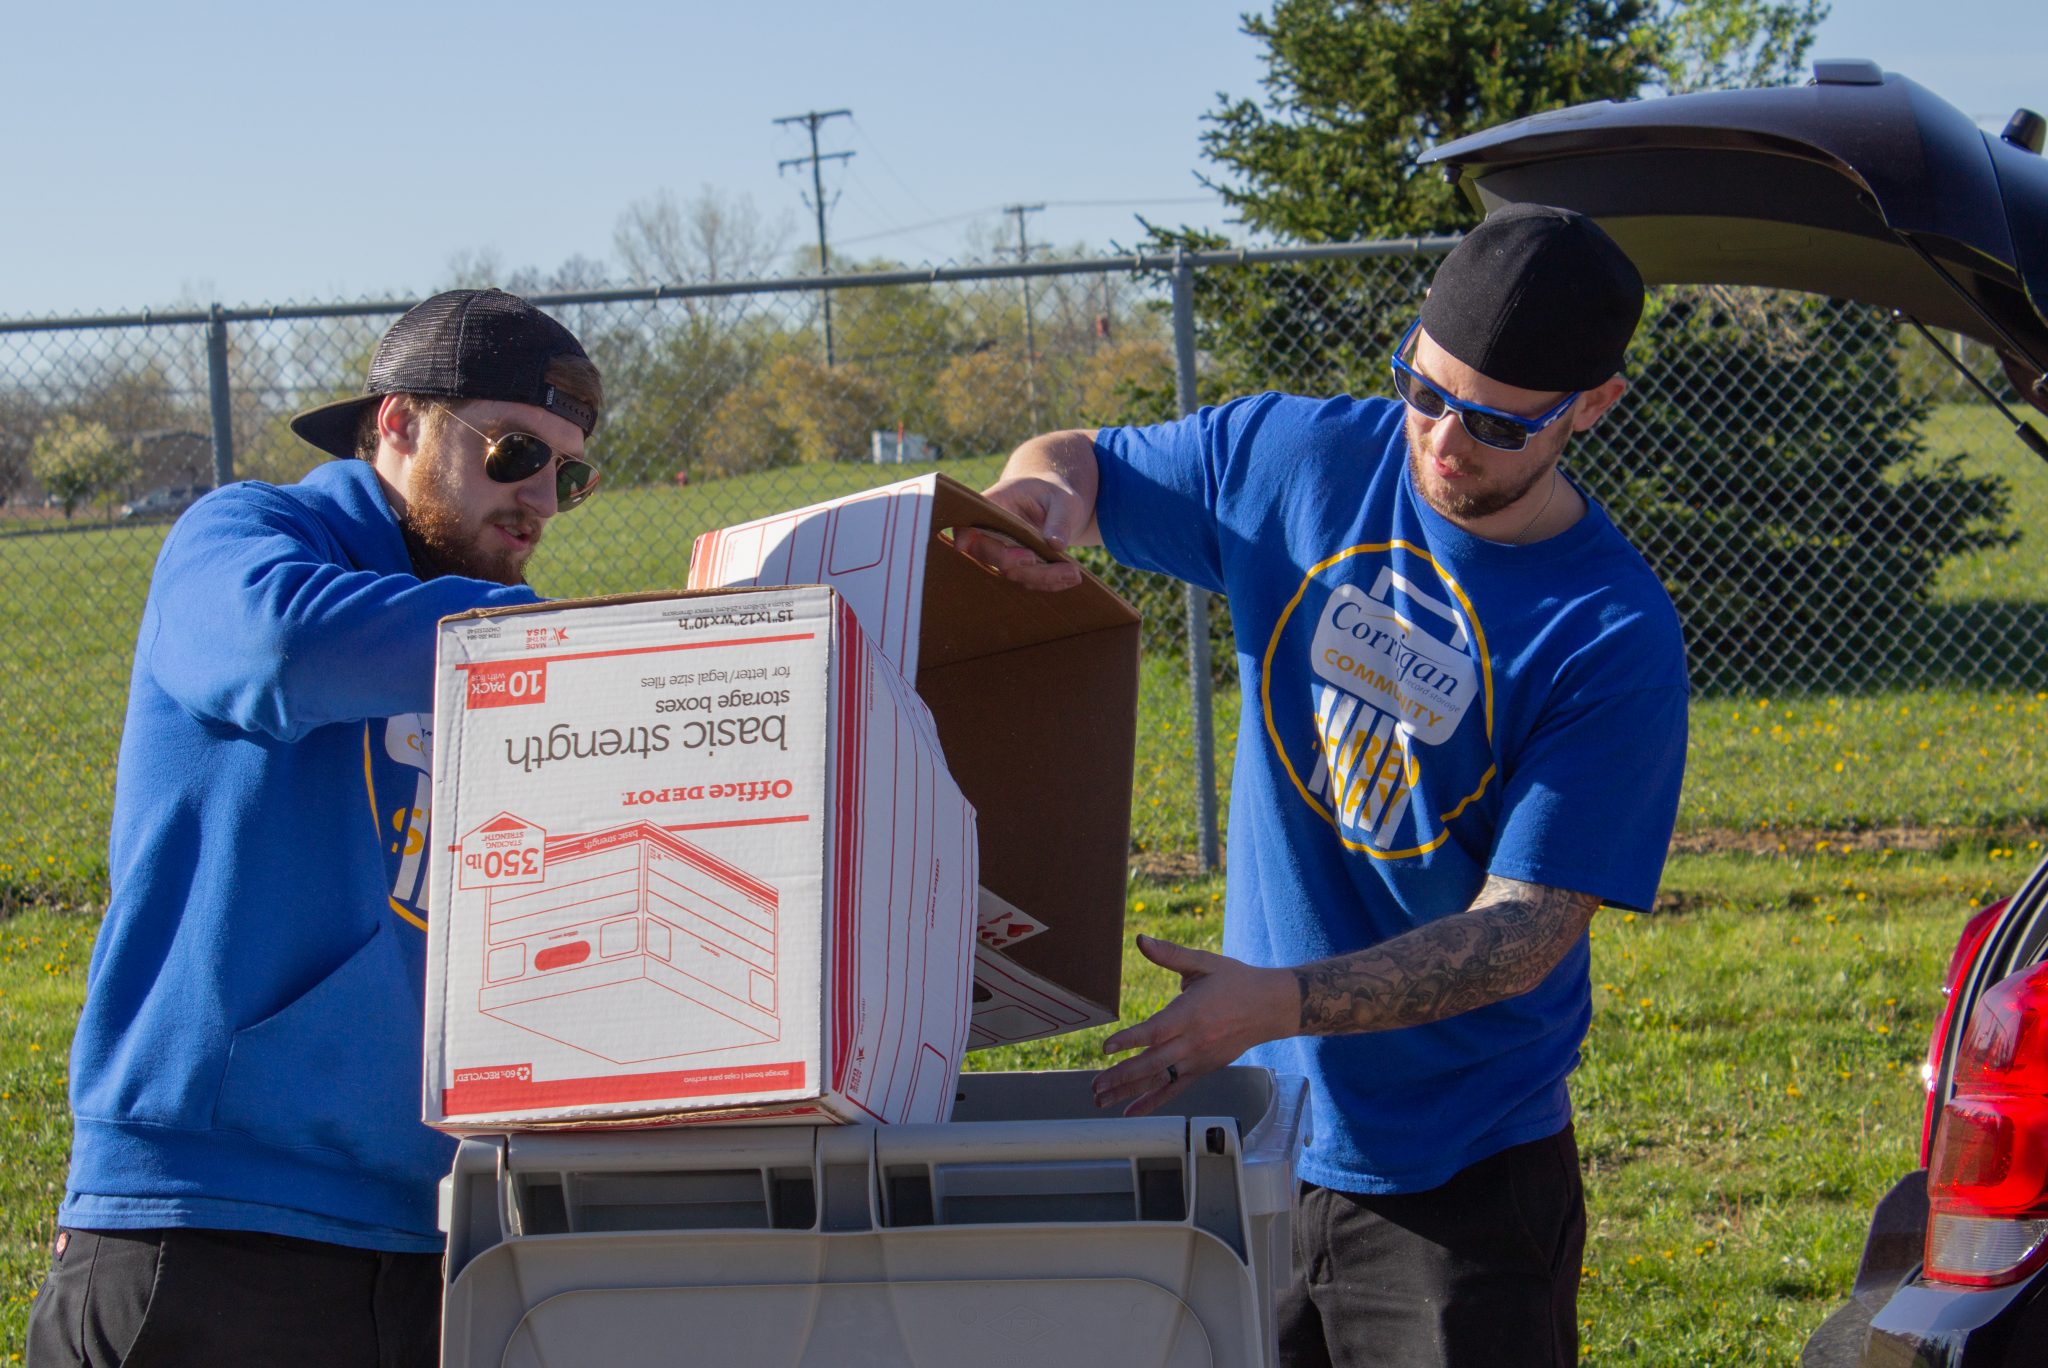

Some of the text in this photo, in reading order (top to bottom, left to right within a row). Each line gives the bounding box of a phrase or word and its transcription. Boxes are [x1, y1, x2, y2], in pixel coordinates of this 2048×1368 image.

[526, 628, 547, 637] USA
[525, 641, 547, 650] MADE
[1332, 601, 1458, 697] Corrigan
[471, 669, 544, 697] 10 PACK
[487, 671, 506, 682] with
[641, 665, 791, 689] for letter/legal size files
[1324, 648, 1444, 728] COMMUNITY
[655, 689, 791, 714] storage boxes
[1429, 689, 1461, 713] storage
[505, 714, 788, 773] basic strength
[622, 779, 793, 806] Office DEPOT
[584, 829, 639, 850] basic strength
[464, 847, 539, 879] 350 lb
[683, 1075, 708, 1084] archivo
[708, 1072, 723, 1081] para
[744, 1071, 764, 1080] boxes
[764, 1069, 790, 1078] storage
